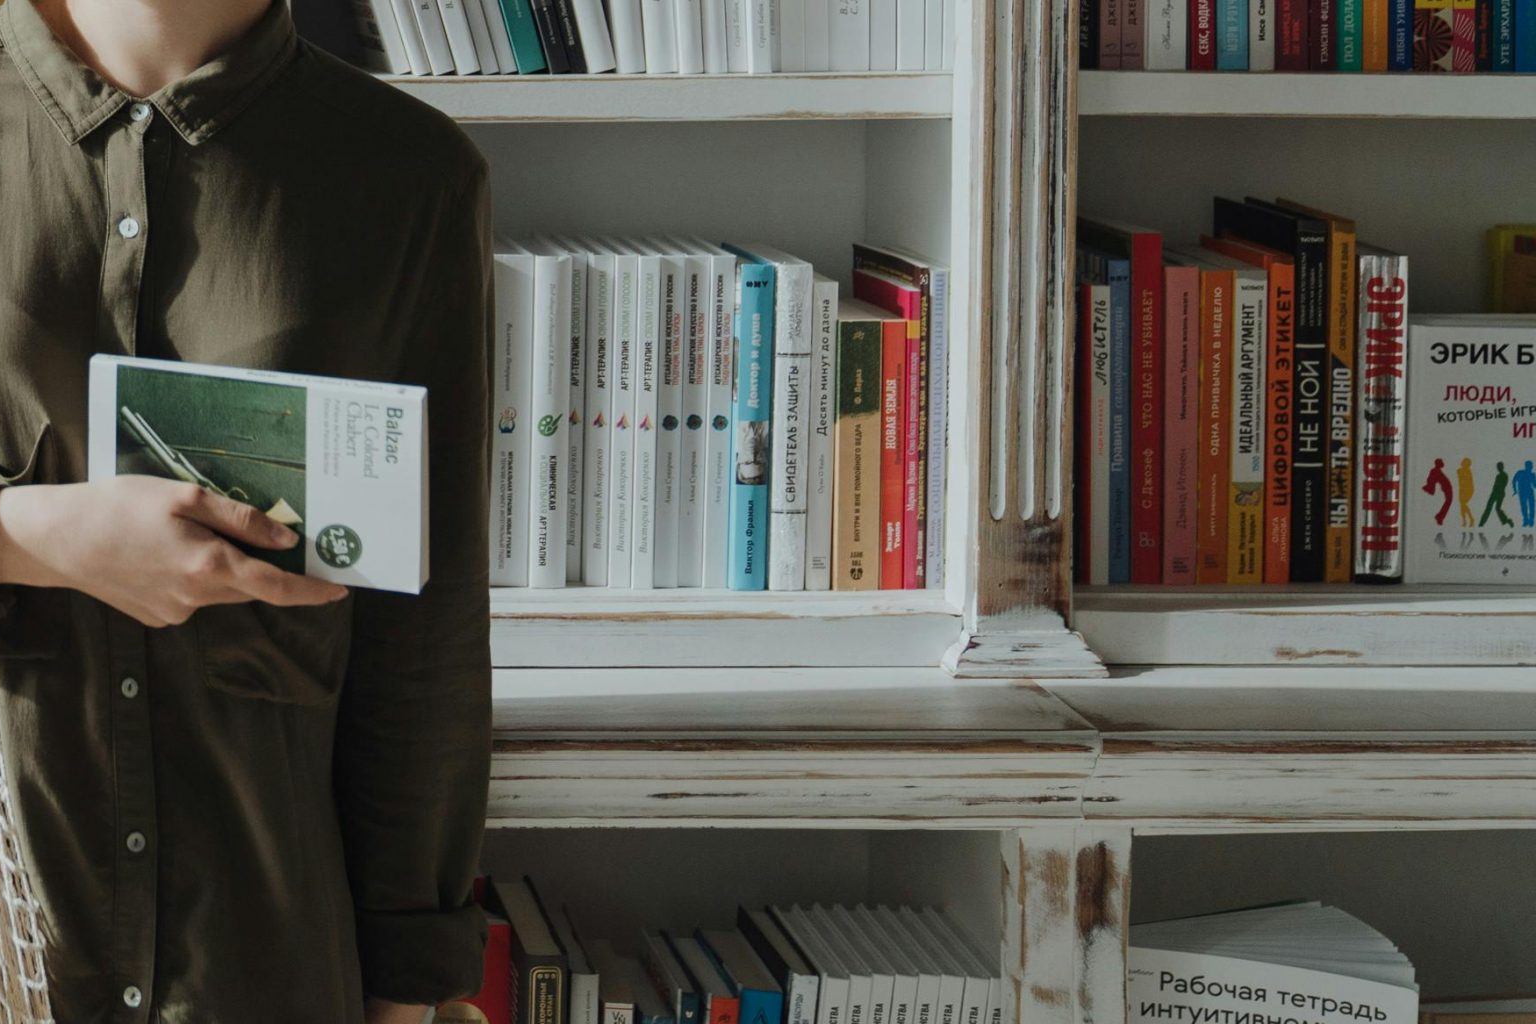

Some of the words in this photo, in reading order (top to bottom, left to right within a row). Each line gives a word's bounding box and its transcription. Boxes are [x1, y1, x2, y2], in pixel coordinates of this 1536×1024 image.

[1198, 31, 1211, 55] СЕКС,
[1501, 43, 1510, 64] УТЕ
[1239, 304, 1256, 369] АРГУМЕНТ
[1274, 285, 1292, 371] ЭТИКЕТ
[1365, 277, 1405, 378] ЭРИК
[1430, 342, 1510, 365] ЭРИК
[364, 404, 379, 421] Le
[786, 366, 799, 421] ЗАЩИТЫ
[1238, 371, 1255, 454] ИДЕАЛЬНЫЙ
[1297, 360, 1321, 415] НОЙ
[1444, 385, 1516, 405] ЛЮДИ,
[346, 401, 362, 456] Chabert
[386, 407, 403, 464] Balzac
[1270, 378, 1292, 507] ЦИФРОВОЙ
[1300, 421, 1320, 452] НЕ
[1437, 407, 1506, 424] КОТОРЫЕ
[363, 426, 378, 479] Colonel
[785, 425, 798, 503] СВИДЕТЕЛЬ
[1362, 454, 1401, 552] БЕРН
[1159, 971, 1267, 1002] Рабочая
[1276, 990, 1387, 1022] тетрадь
